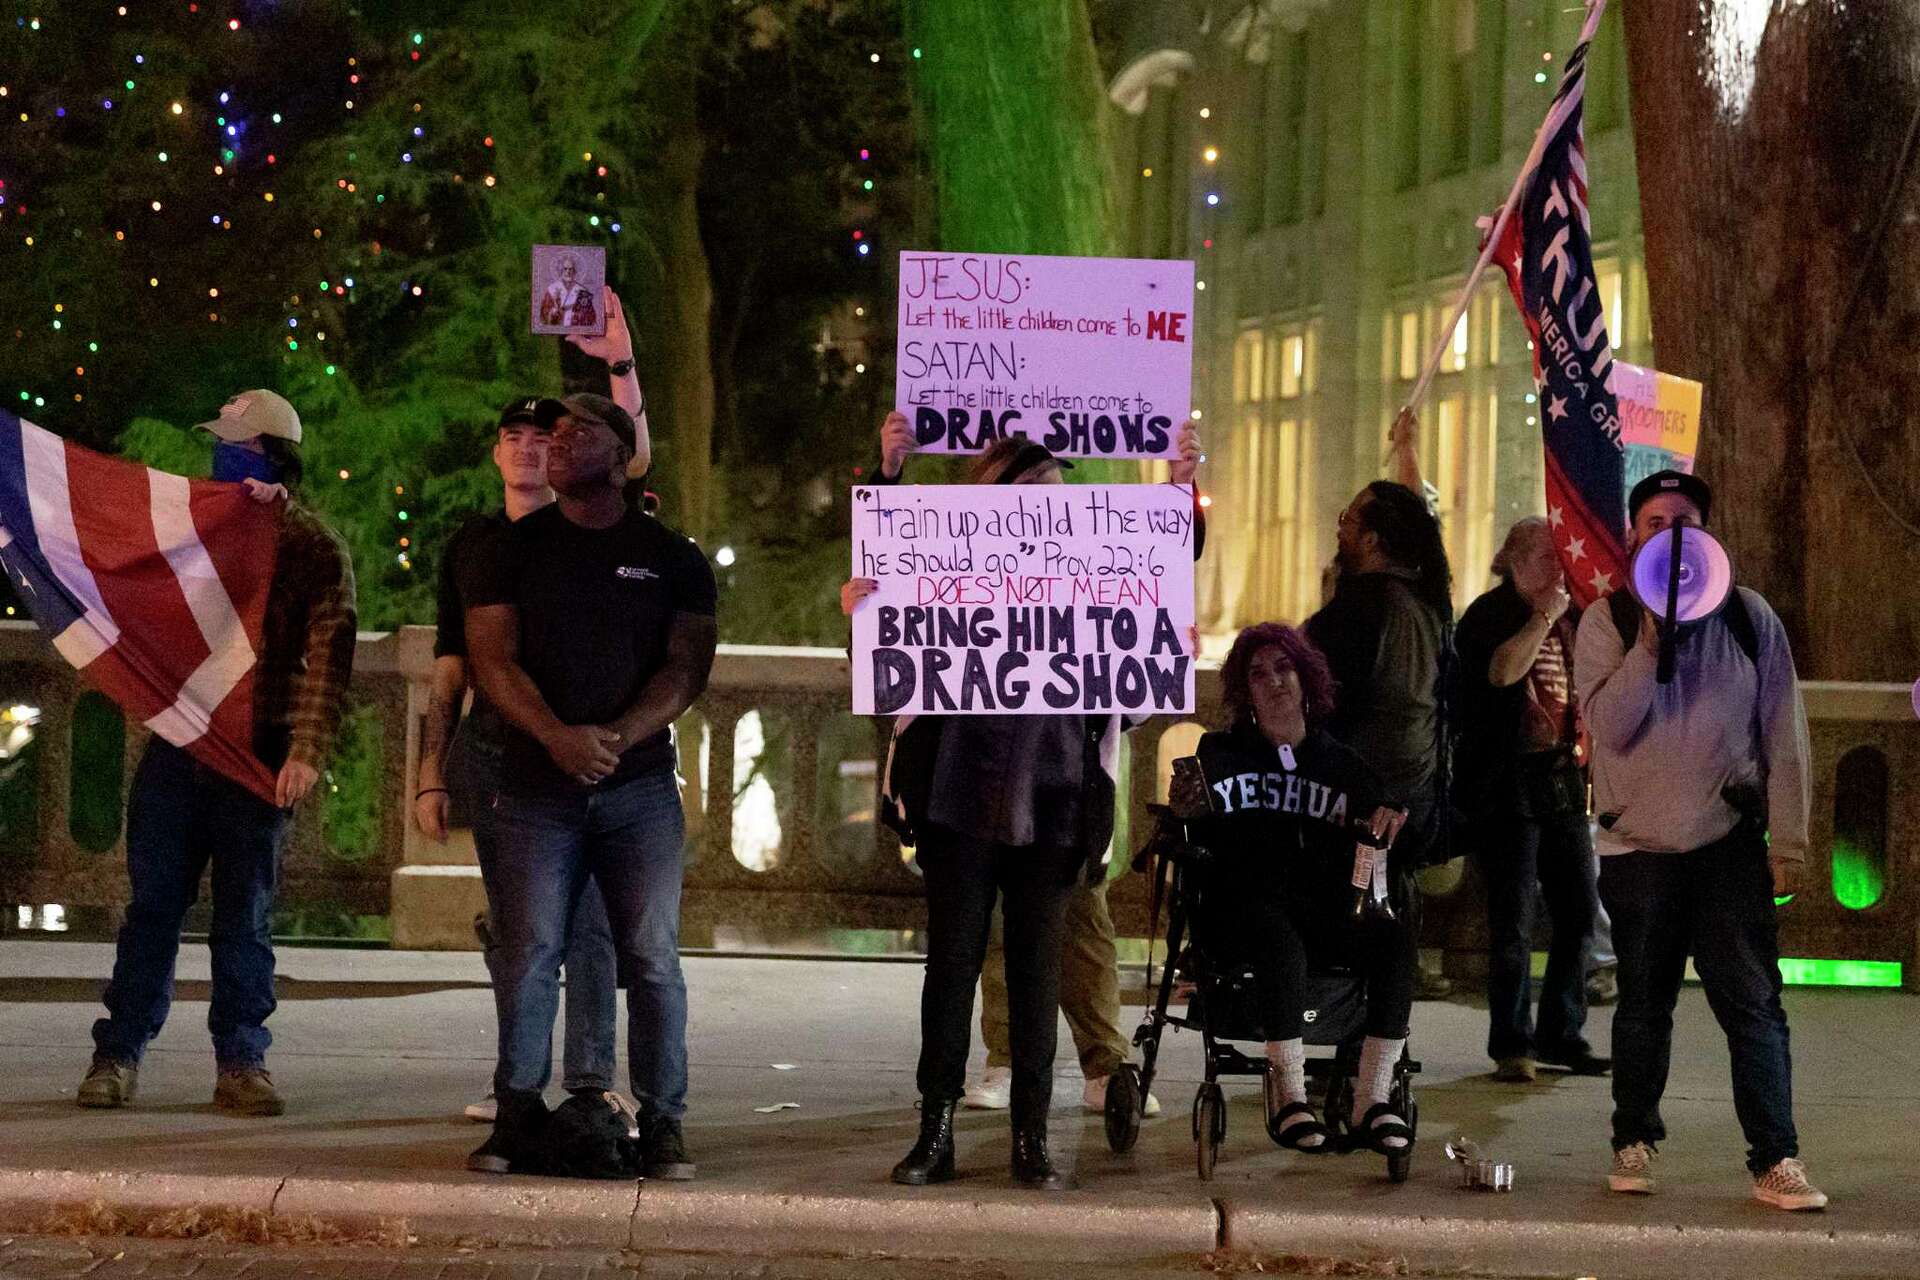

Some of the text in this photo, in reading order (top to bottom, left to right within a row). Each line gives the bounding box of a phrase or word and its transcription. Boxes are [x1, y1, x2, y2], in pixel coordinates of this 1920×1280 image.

[906, 258, 1030, 303] JESUS:
[906, 303, 1187, 343] Let the little children come to ME
[902, 341, 1025, 381] SATAN:
[1538, 296, 1590, 400] MERICA
[908, 384, 1153, 414] Let the little children come to
[915, 407, 1172, 455] DRAG SHOWS
[949, 506, 979, 549] up
[985, 509, 1002, 537] a
[1005, 494, 1073, 538] child
[1085, 491, 1138, 536] the
[1147, 508, 1192, 547] way
[861, 539, 890, 576] he
[896, 543, 973, 576] should
[1098, 545, 1165, 577] 22:6
[917, 576, 1159, 607] DOES NOT MEAN
[877, 606, 1183, 655] BRING HIM TO A
[872, 648, 1190, 714] DRAG SHOW
[1212, 772, 1347, 826] YESHUA
